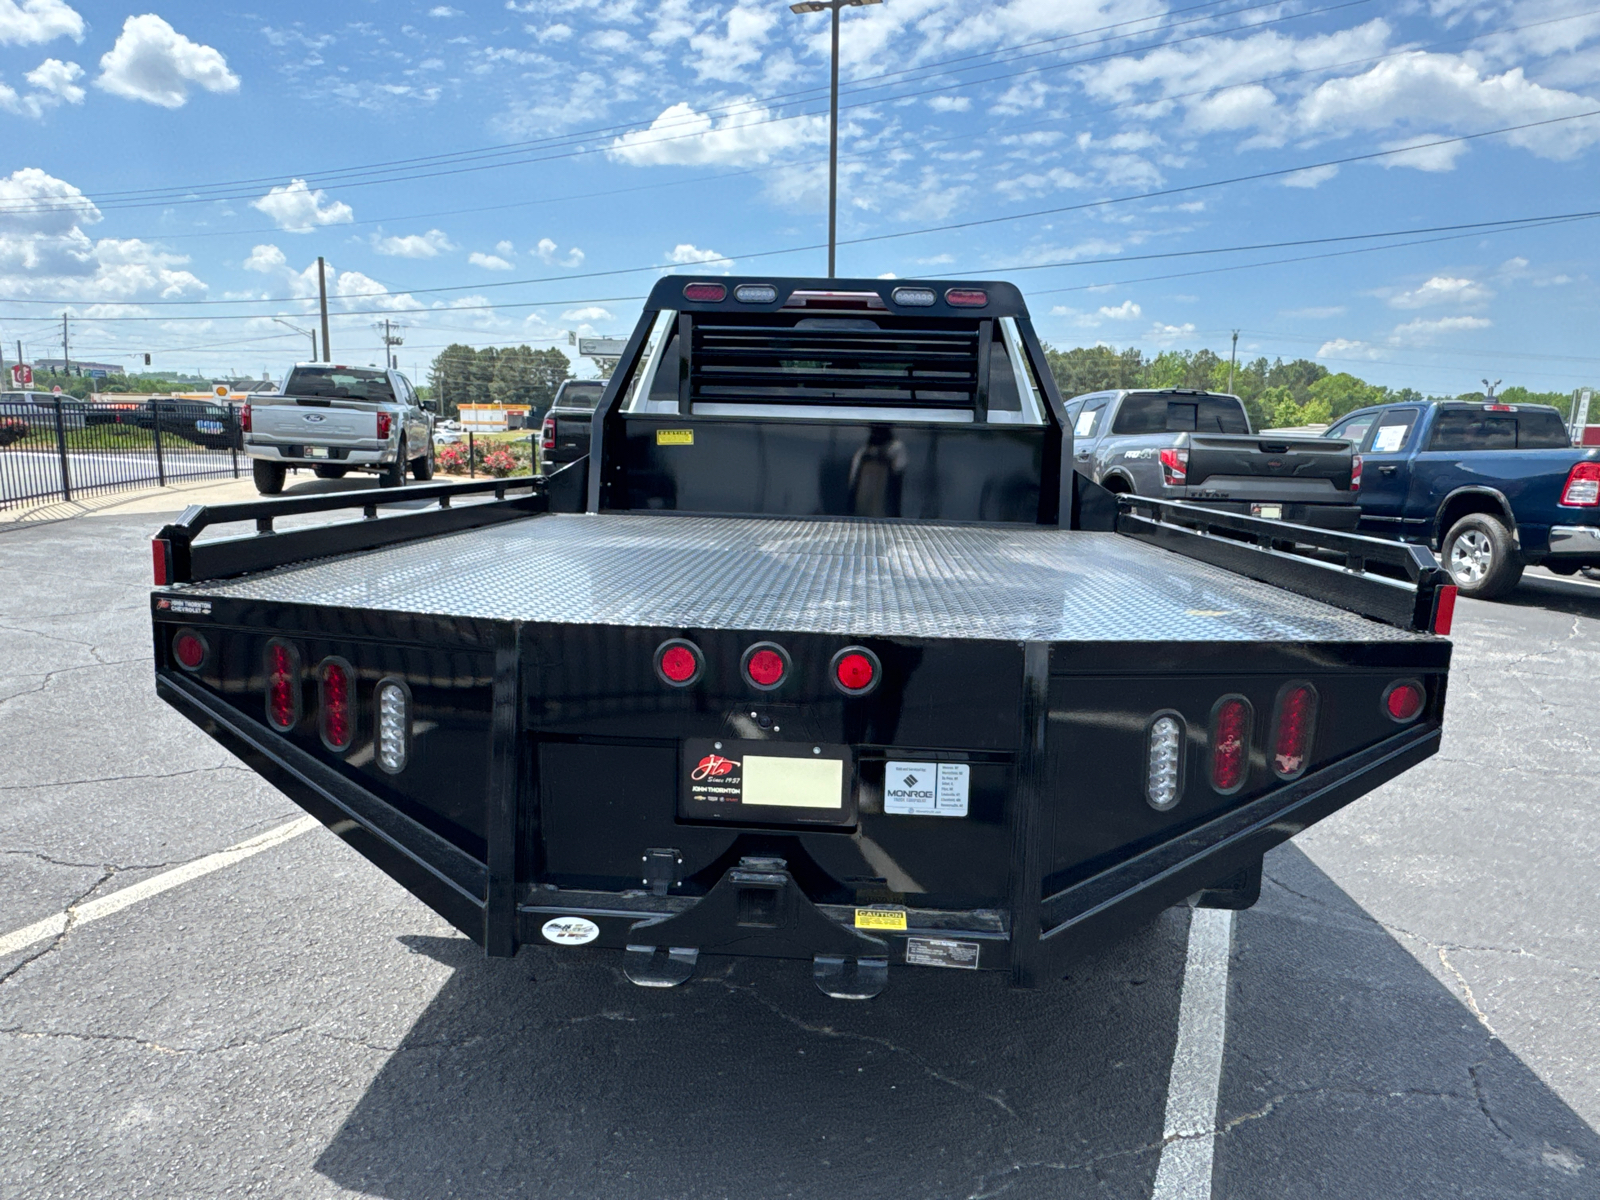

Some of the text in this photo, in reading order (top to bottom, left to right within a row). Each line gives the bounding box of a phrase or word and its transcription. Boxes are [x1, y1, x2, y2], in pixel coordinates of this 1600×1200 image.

[184, 601, 212, 609] THORNTON
[708, 786, 741, 795] THORNTON
[887, 790, 933, 798] MONROE
